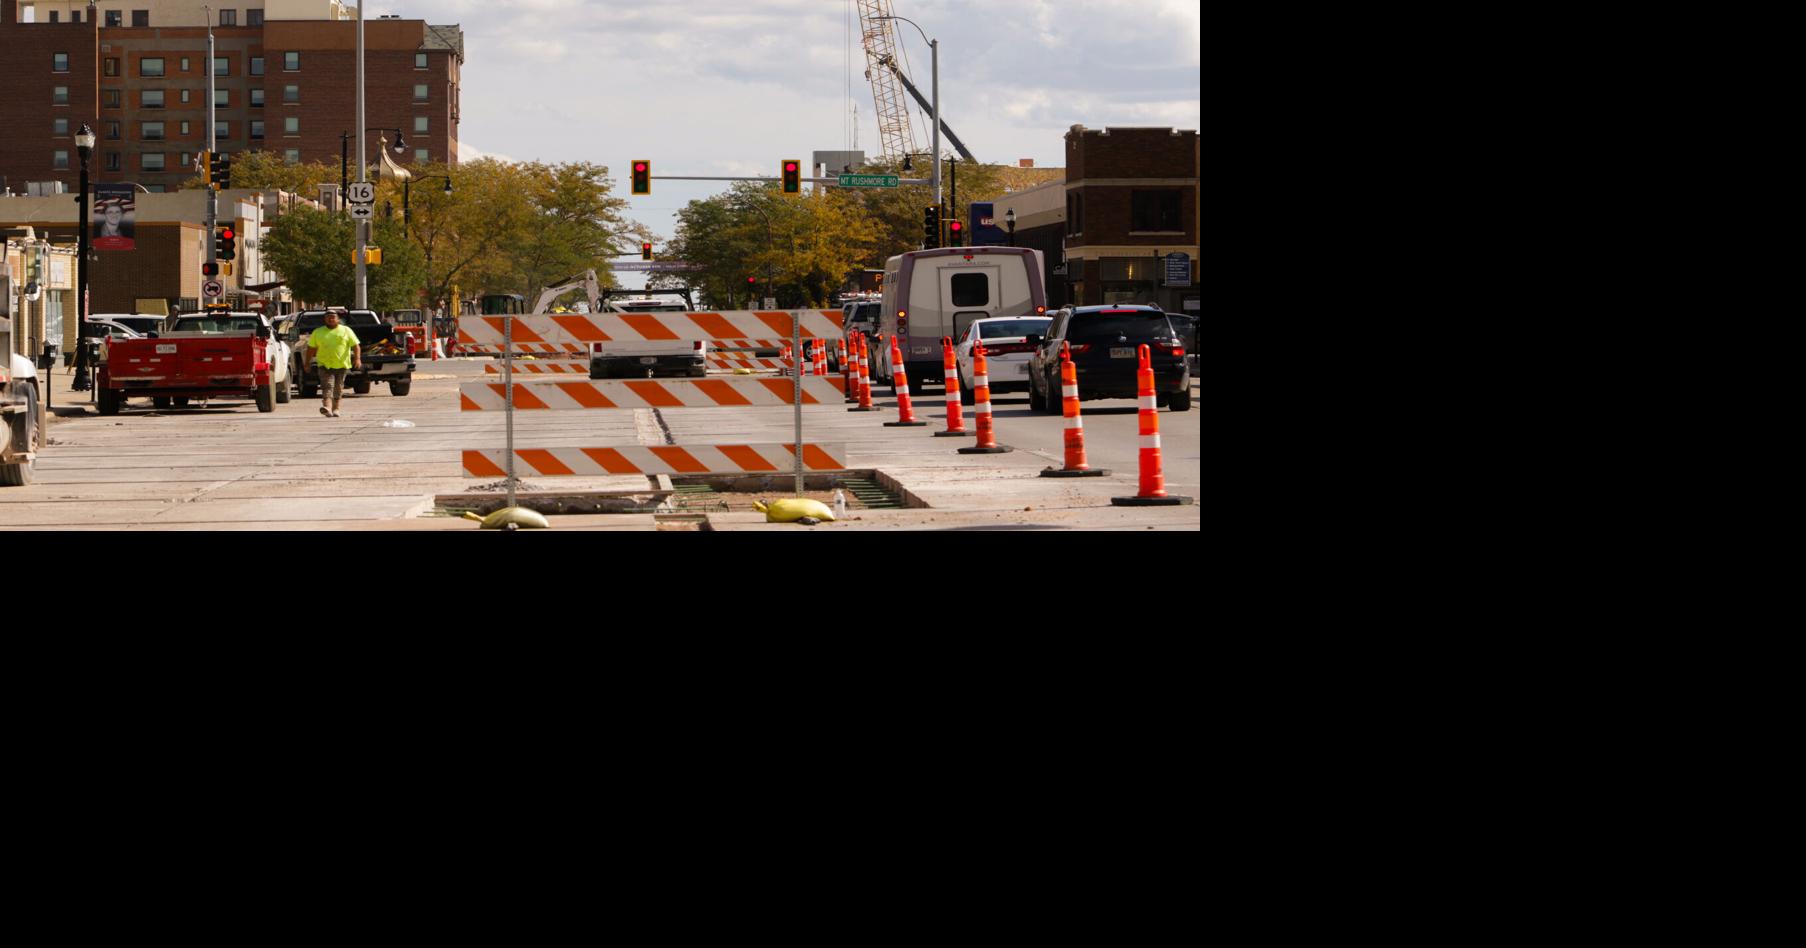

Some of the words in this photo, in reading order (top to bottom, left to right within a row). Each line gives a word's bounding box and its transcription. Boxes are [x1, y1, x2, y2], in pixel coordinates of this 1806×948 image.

[841, 177, 849, 185] MT
[851, 177, 885, 186] RUSHMORE
[888, 178, 897, 186] RD
[353, 186, 370, 198] 16
